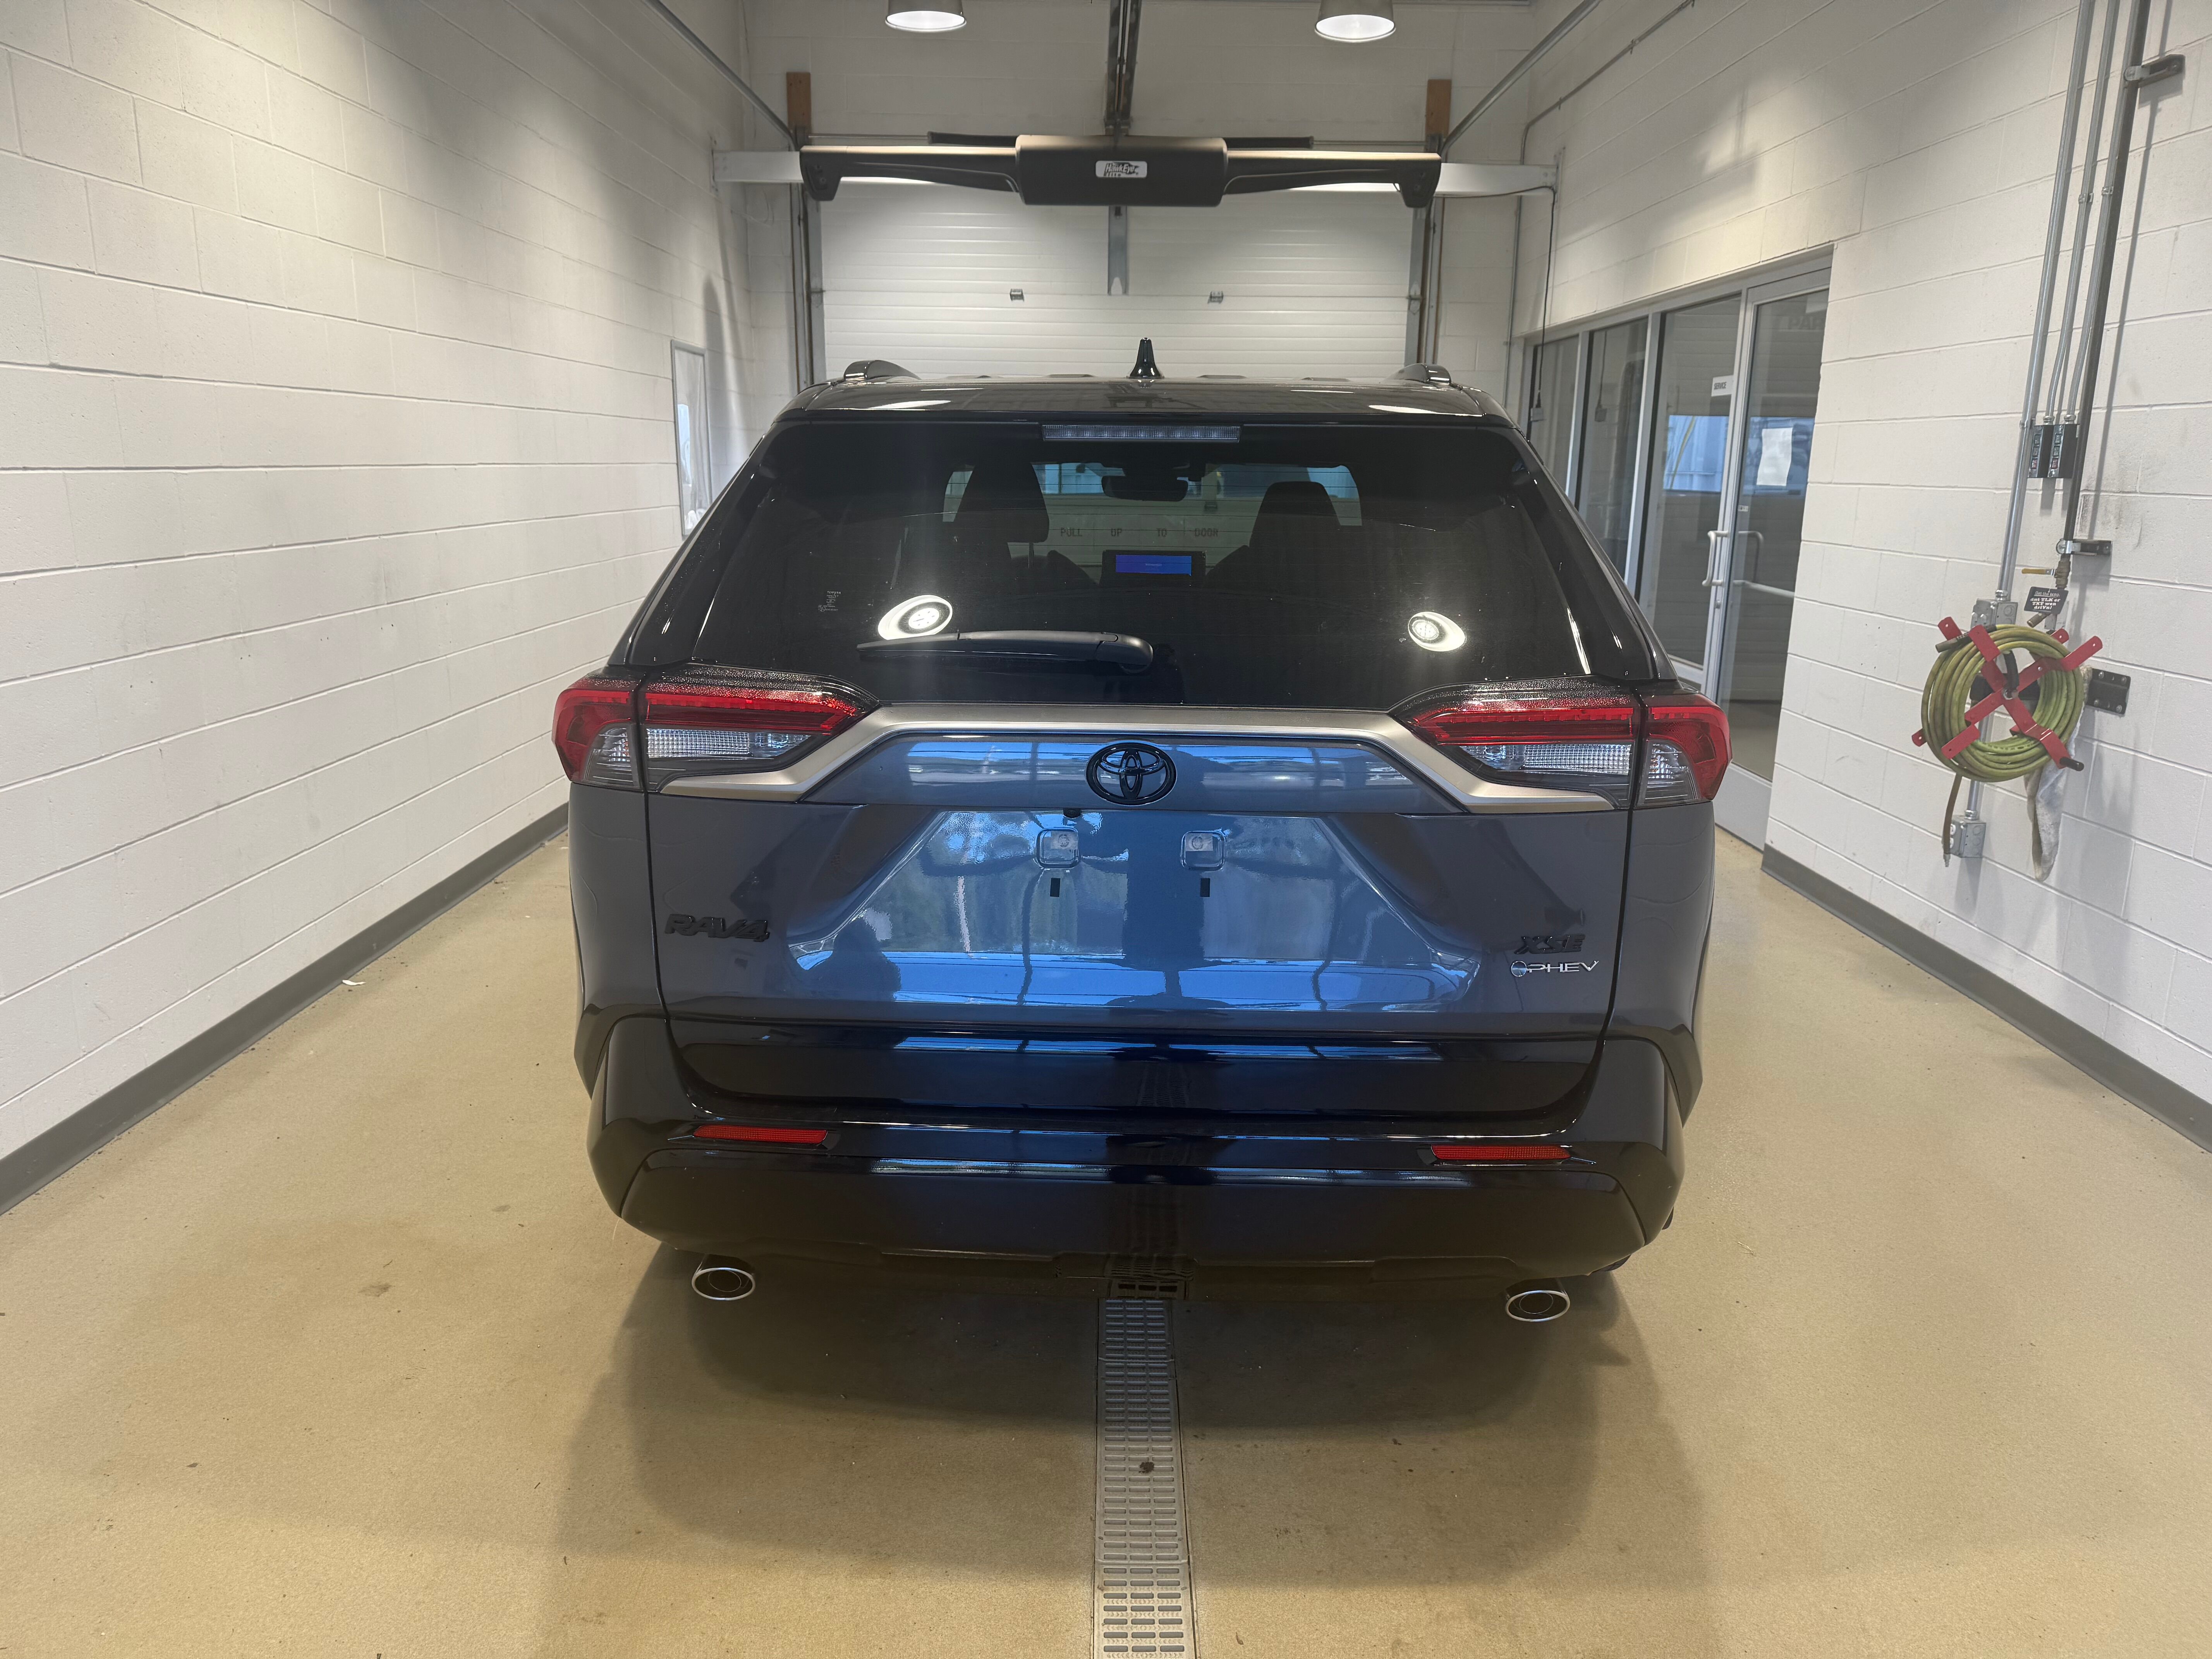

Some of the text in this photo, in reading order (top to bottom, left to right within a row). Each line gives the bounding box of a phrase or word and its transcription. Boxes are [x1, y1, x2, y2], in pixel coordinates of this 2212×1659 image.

[1105, 163, 1135, 173] HawkEye
[1714, 381, 1727, 390] SERVICE
[1060, 527, 1219, 537] PULL UP TO DOOR
[665, 914, 770, 942] RAV4
[1514, 933, 1586, 955] XSE
[1527, 960, 1599, 973] PHEV
